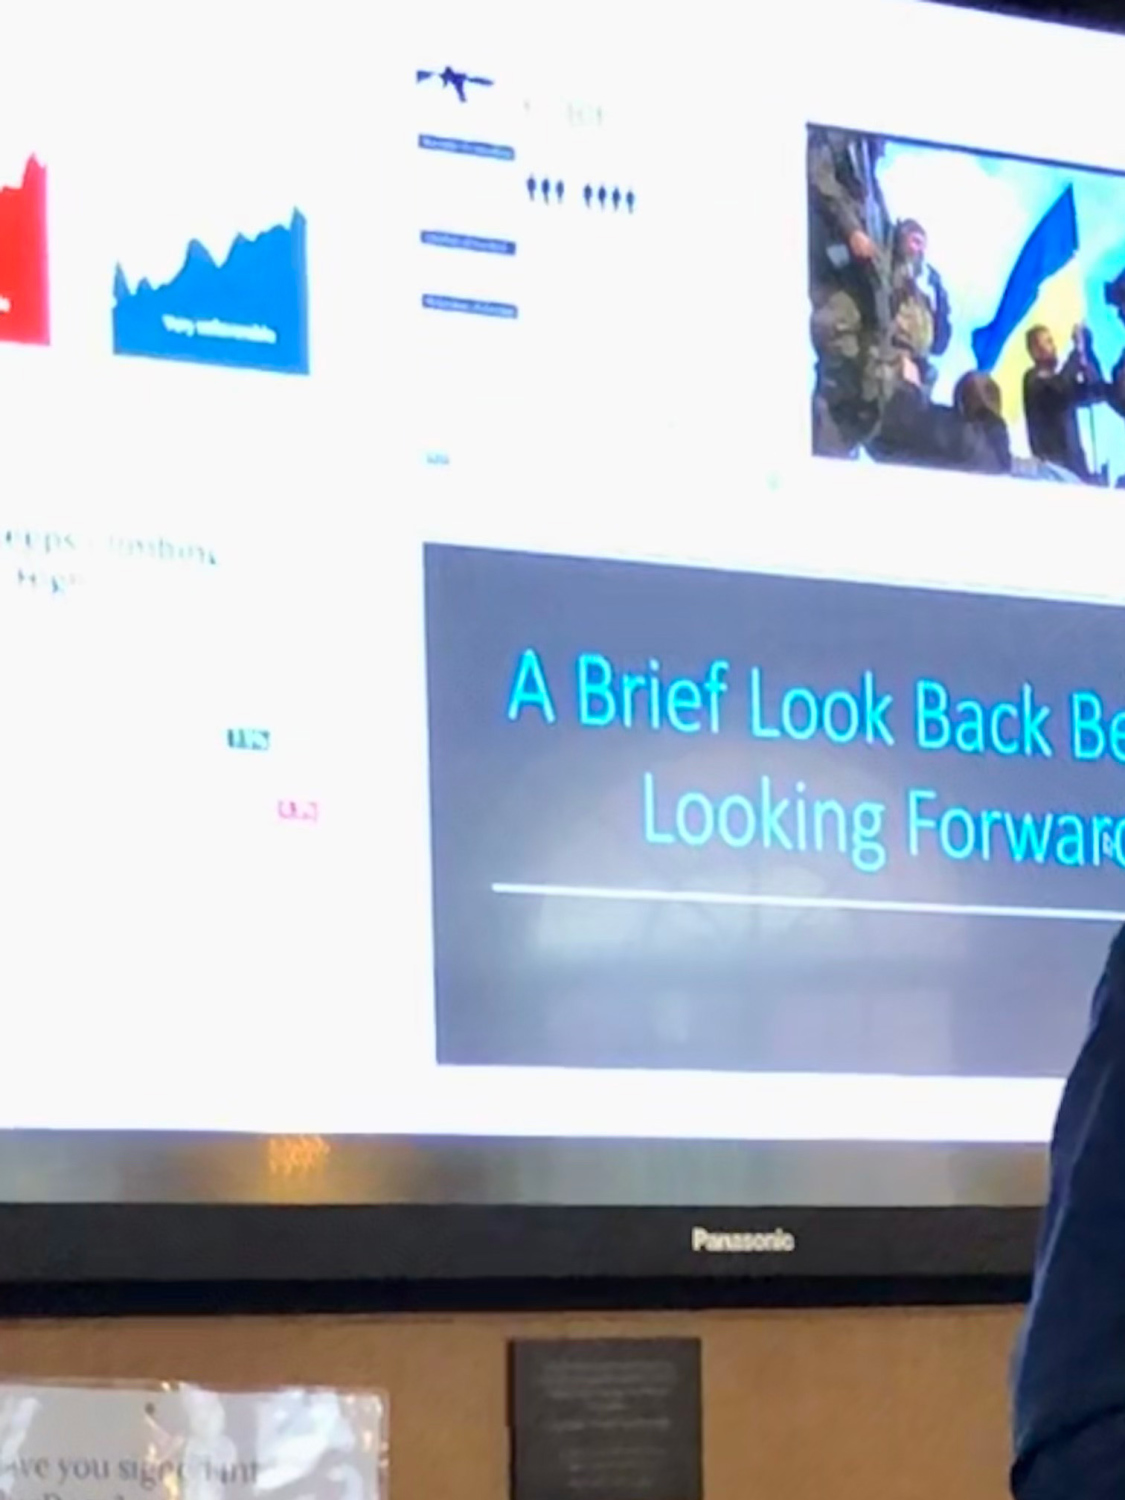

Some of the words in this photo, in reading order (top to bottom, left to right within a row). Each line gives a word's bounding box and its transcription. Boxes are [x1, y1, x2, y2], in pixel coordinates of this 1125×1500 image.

[507, 648, 556, 724] A
[576, 653, 730, 736] Brief
[749, 667, 895, 747] Look
[915, 679, 1054, 759] Back
[642, 772, 888, 873] Looking
[691, 1227, 795, 1252] Panasonic
[57, 1459, 110, 1485] you
